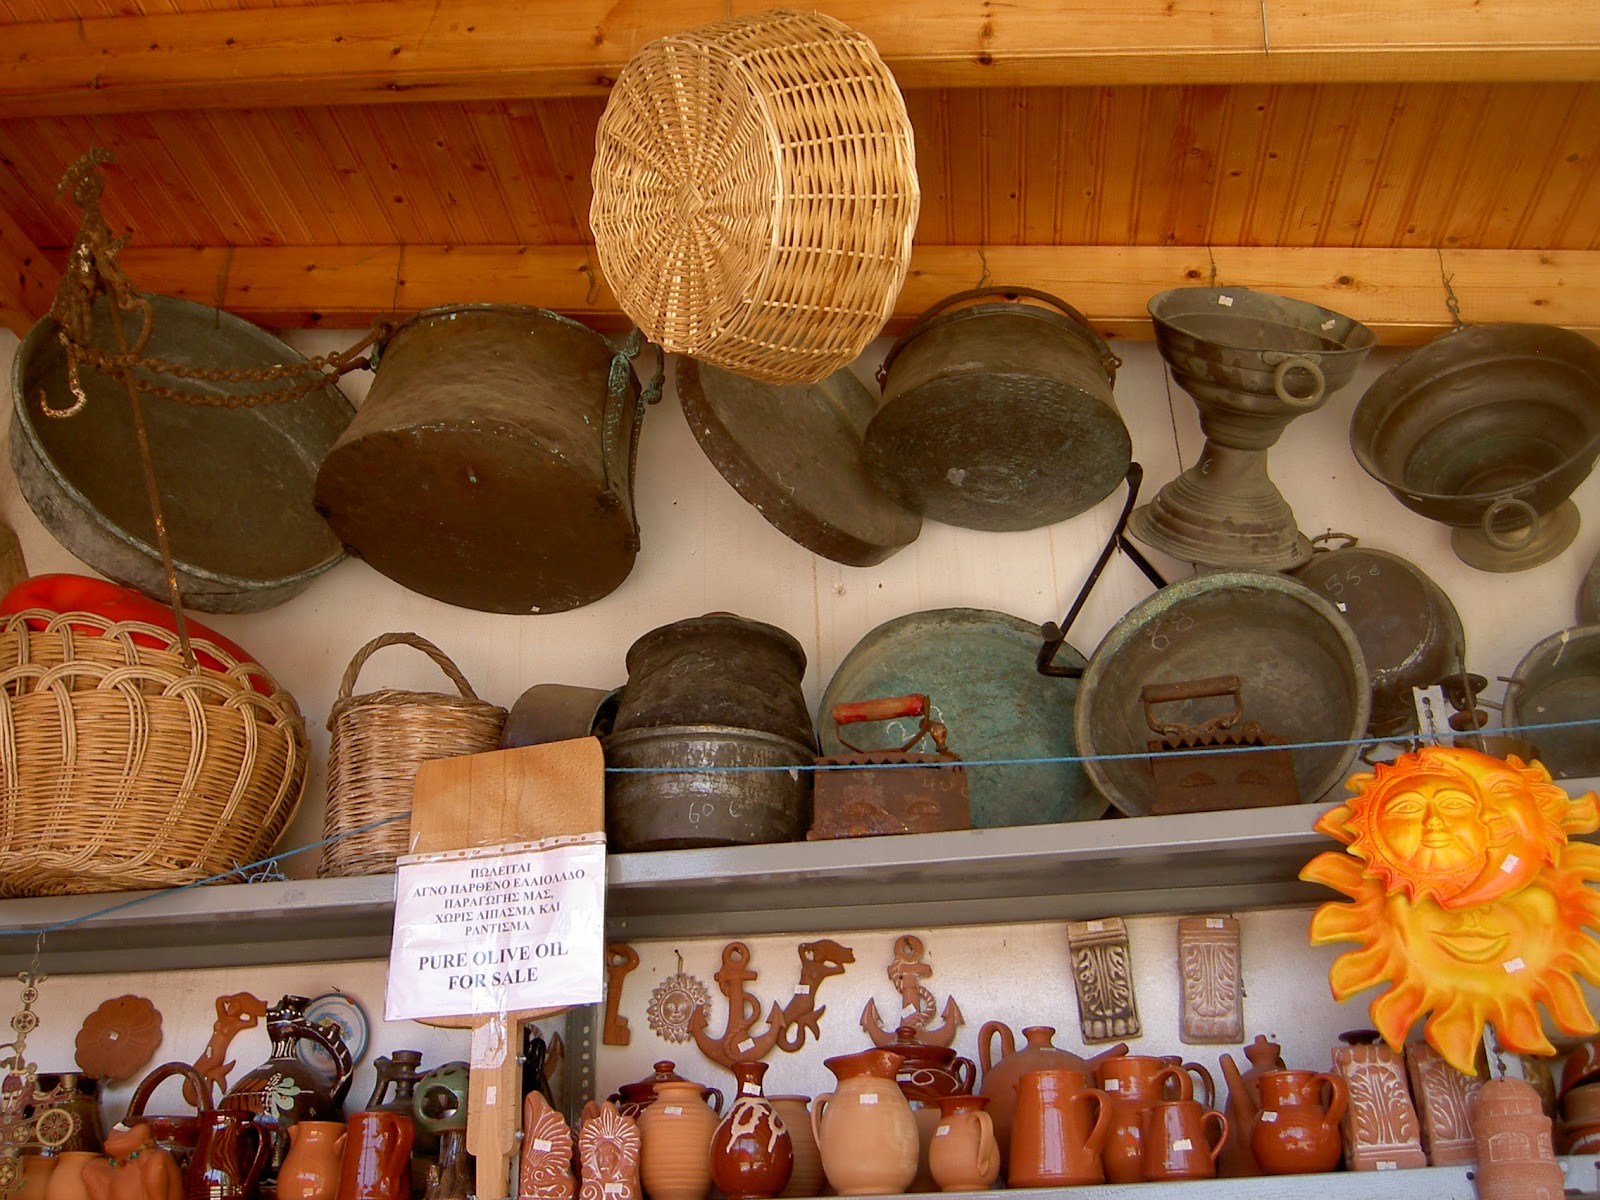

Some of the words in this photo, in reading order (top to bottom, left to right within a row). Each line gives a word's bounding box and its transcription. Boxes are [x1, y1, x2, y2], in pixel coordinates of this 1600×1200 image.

[470, 863, 532, 879] ΠΩΛΕΙΤΑΙ
[413, 885, 448, 898] ΑΓΝΟ
[450, 878, 511, 895] ΠΑΡΘΕΝΟ
[513, 868, 585, 888] ΕΛΑΙΟΛΑΔΟ
[444, 892, 520, 909] ΠΑΡΑΓΩΓΗΣ
[523, 889, 554, 901] ΜΑΣ,
[435, 912, 474, 924] ΧΩΡΙΣ
[476, 904, 536, 921] ΛΙΠΑΣΜΑ
[539, 901, 561, 914] ΚΑΙ
[465, 920, 530, 936] ΡΑΝΤΙΣΜΑ
[418, 952, 468, 971] PURE
[472, 945, 531, 966] OLIVE
[535, 941, 569, 958] OIL
[448, 973, 487, 990] FOR
[491, 966, 539, 987] SALE
